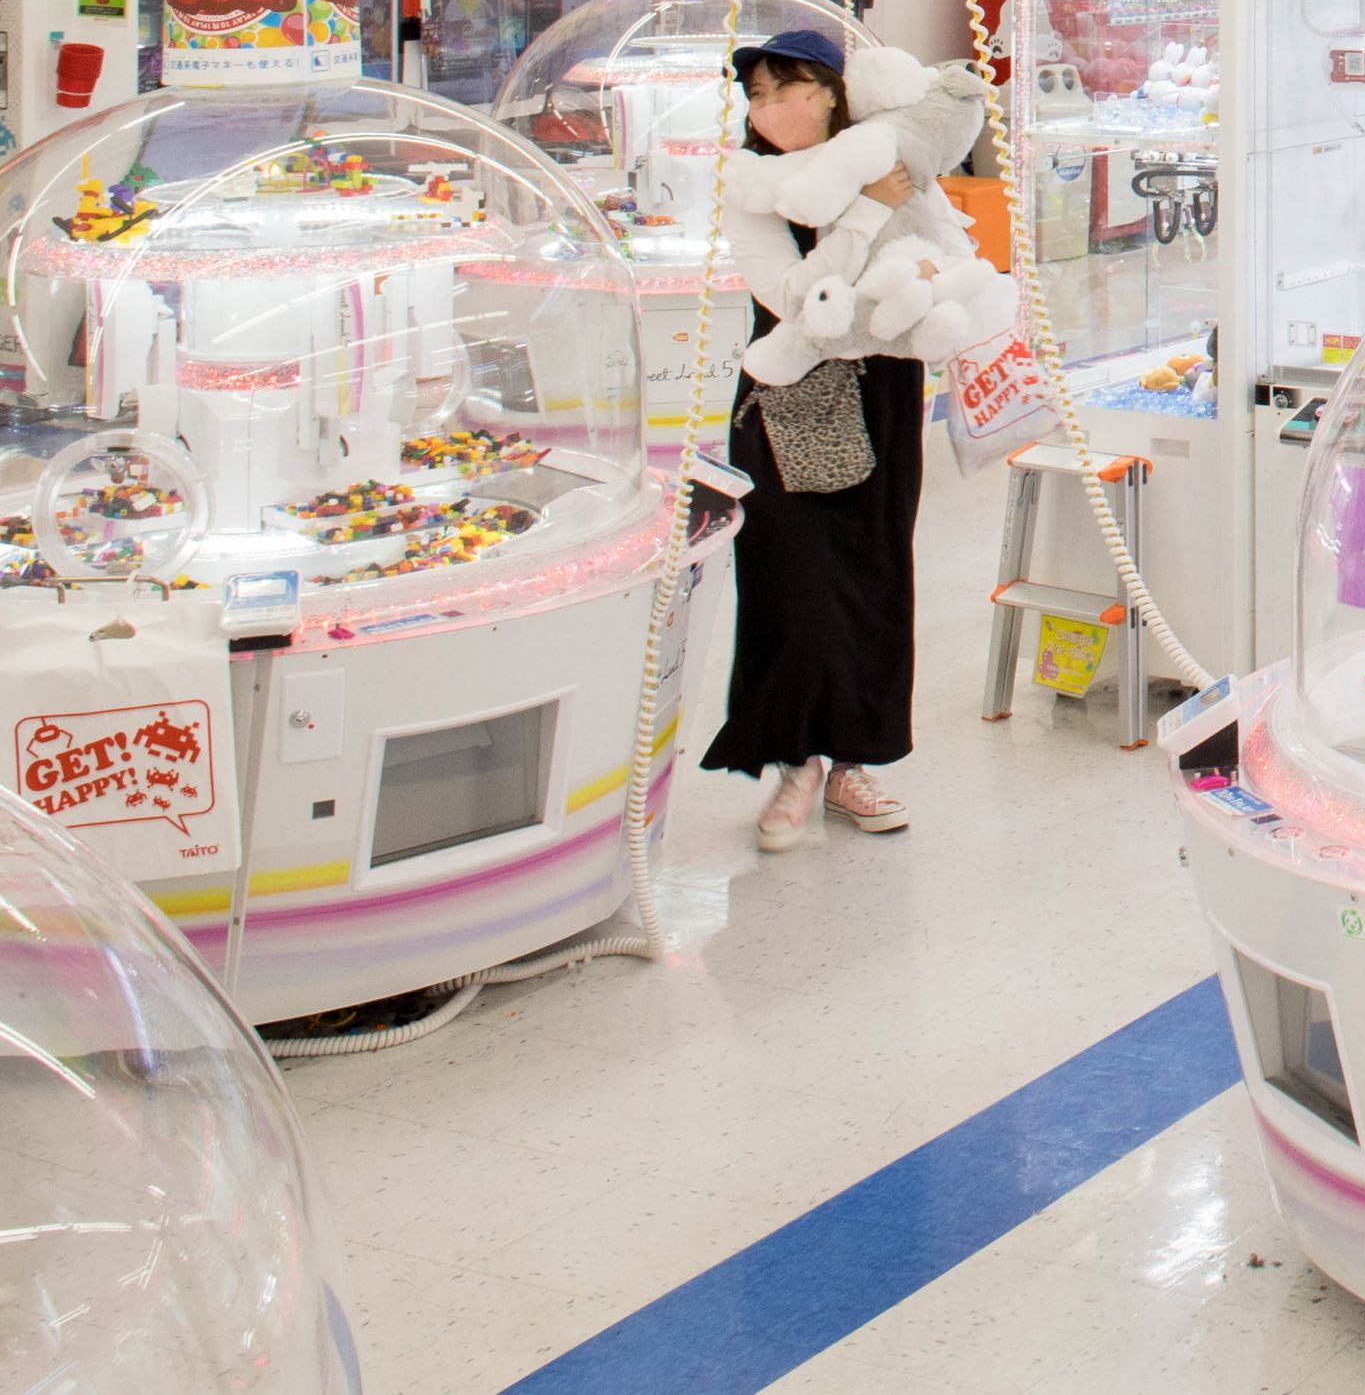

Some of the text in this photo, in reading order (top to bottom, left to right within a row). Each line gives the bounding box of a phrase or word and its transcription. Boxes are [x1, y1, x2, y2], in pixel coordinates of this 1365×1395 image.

[722, 360, 734, 379] 5
[25, 732, 132, 792] GET!
[33, 767, 138, 816] HAPPY!
[180, 844, 219, 859] TAITO
